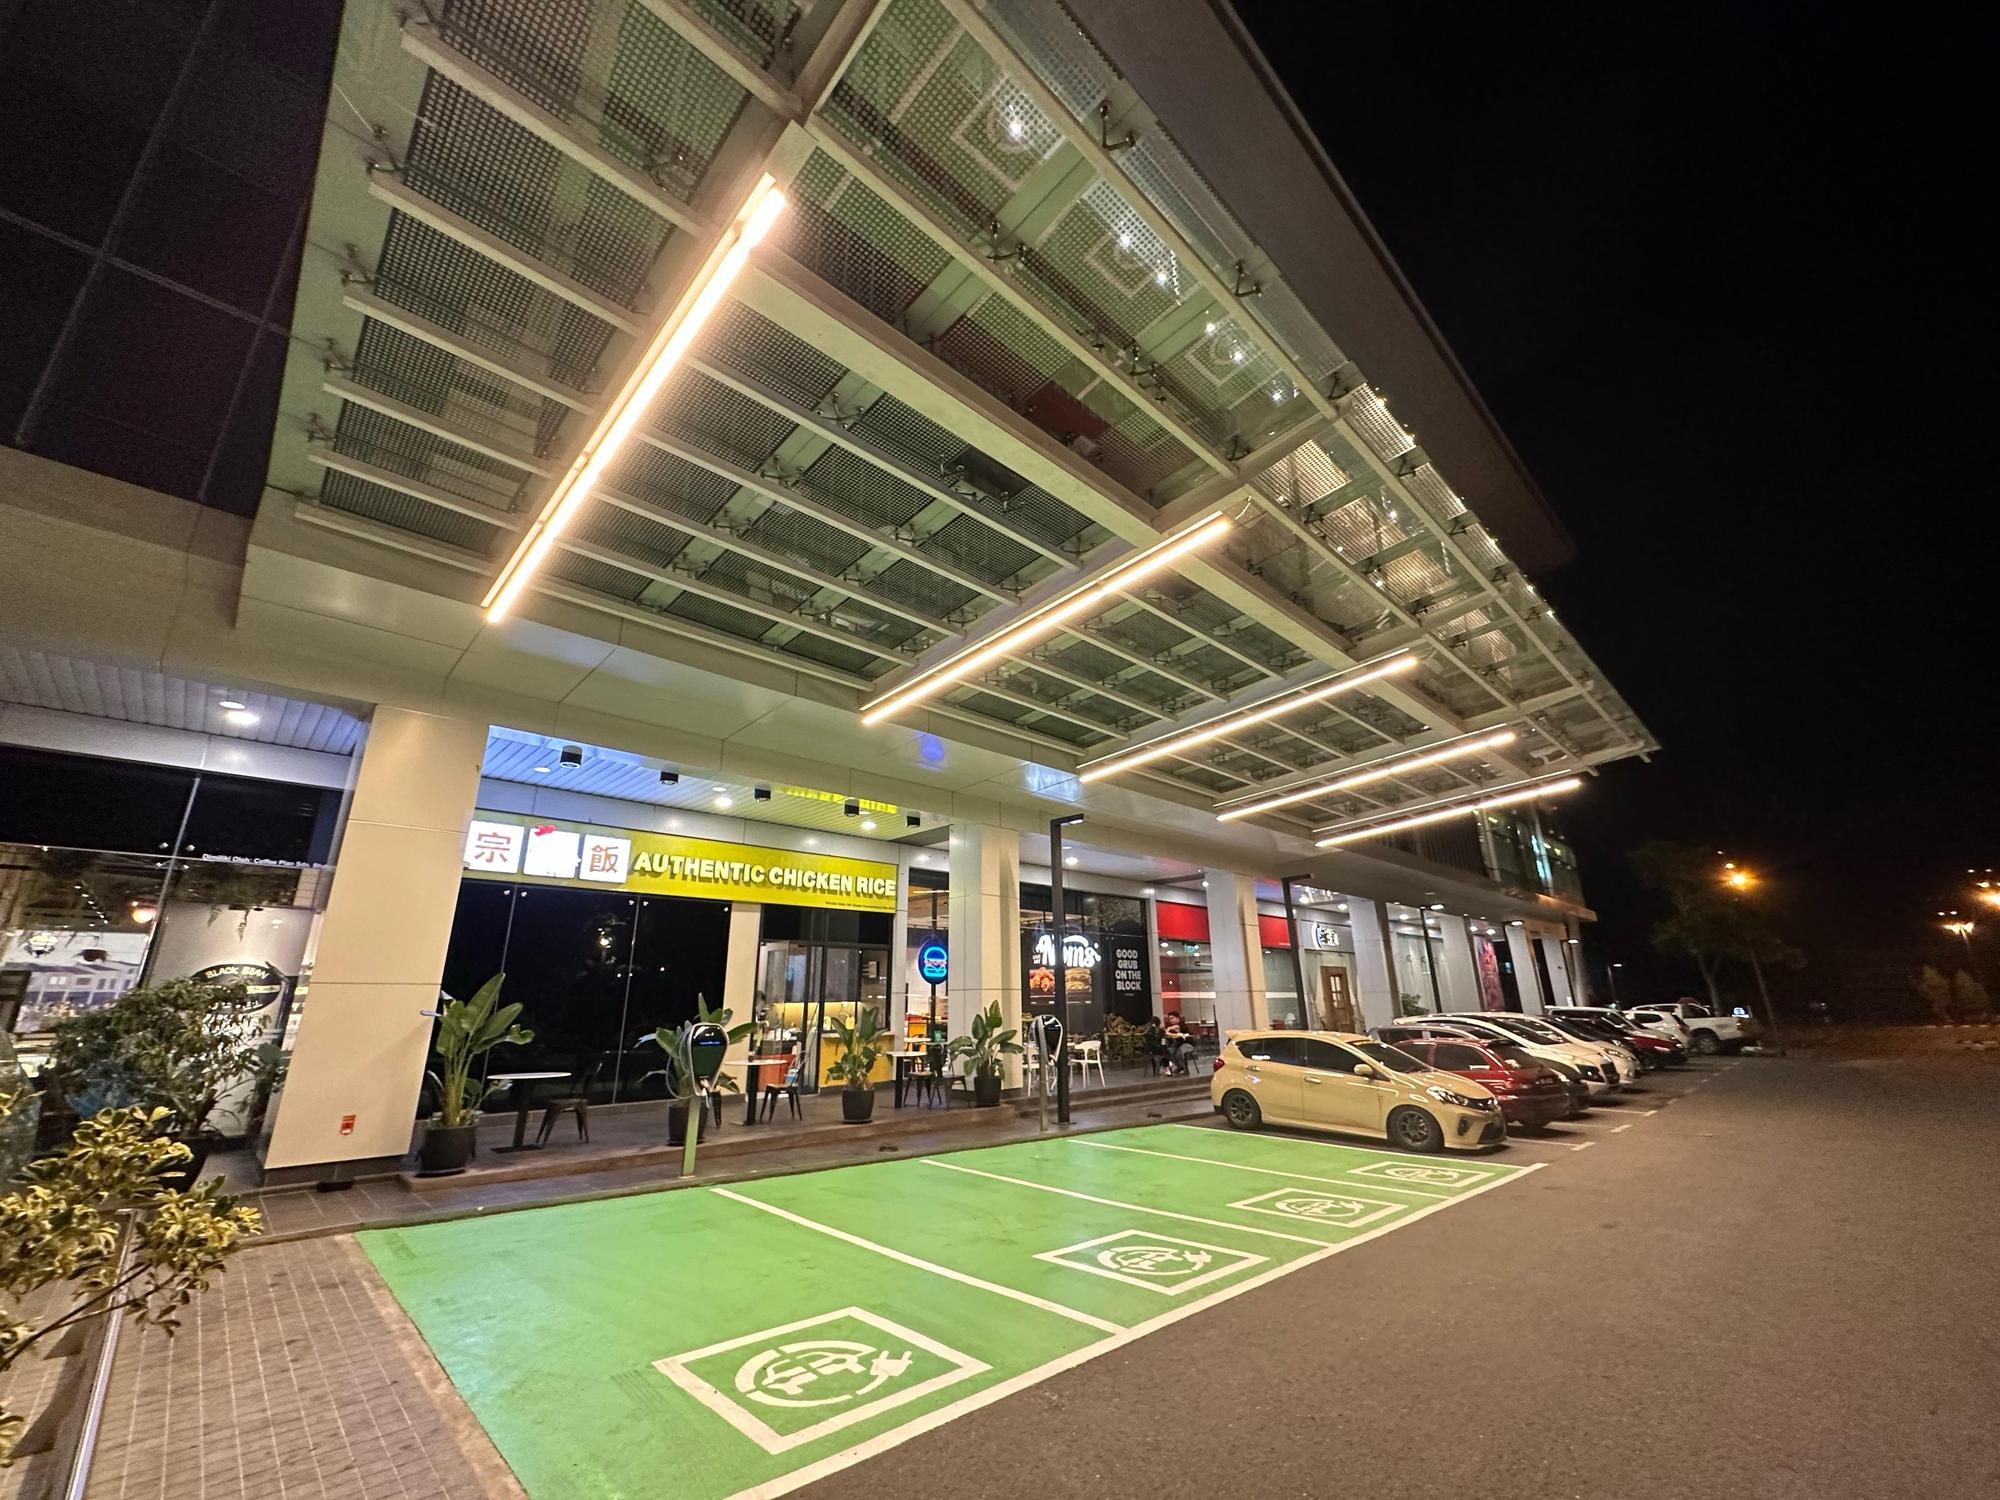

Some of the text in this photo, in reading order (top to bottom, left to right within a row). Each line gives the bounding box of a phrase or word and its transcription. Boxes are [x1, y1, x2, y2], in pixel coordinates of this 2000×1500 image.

[474, 832, 619, 873] 宗 飯
[633, 851, 897, 897] AUTHENTIC CHICKEN RICE
[1116, 949, 1138, 959] GOOD
[1117, 960, 1138, 970] GRUB
[205, 966, 271, 980] BLACK BEAN
[1115, 970, 1142, 980] ON THE
[1116, 981, 1142, 991] BLOCK
